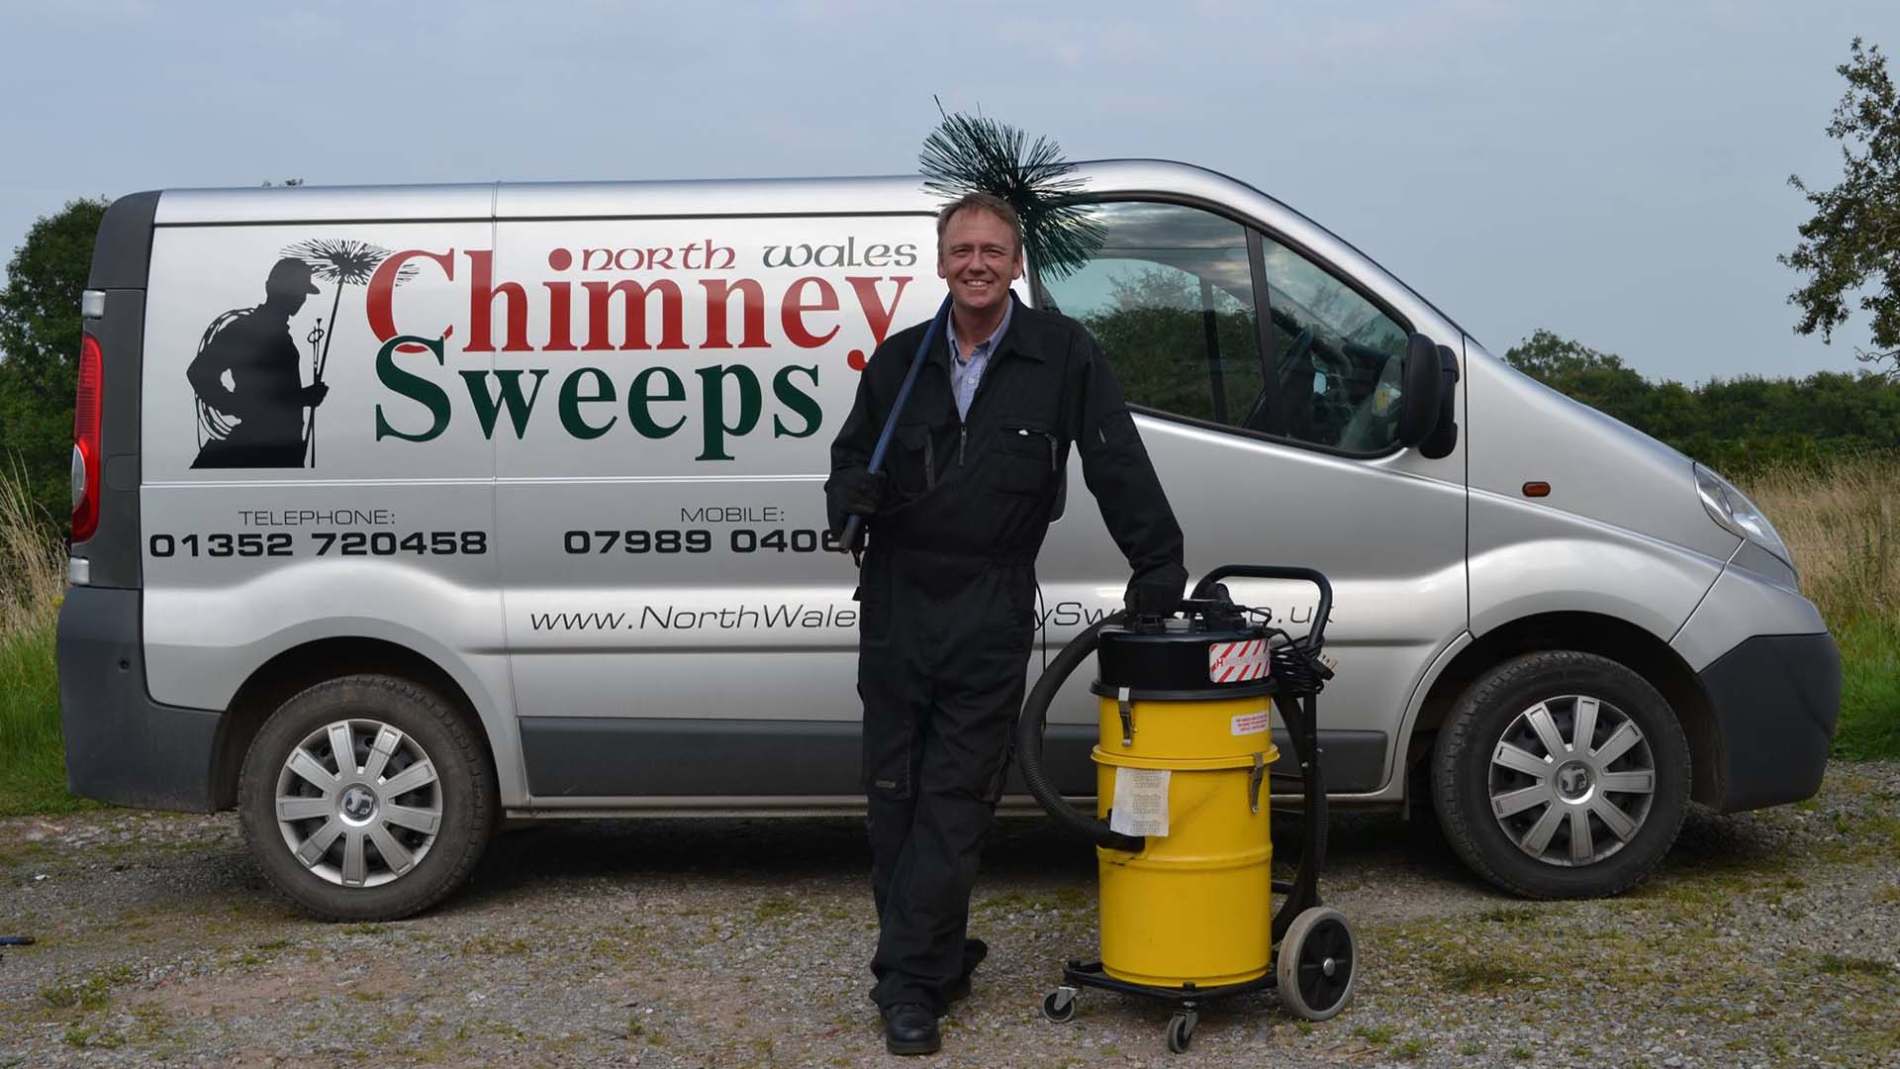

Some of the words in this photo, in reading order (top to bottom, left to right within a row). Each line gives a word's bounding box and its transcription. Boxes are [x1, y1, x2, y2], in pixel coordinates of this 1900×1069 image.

[366, 247, 914, 372] Chimney
[375, 335, 824, 462] Sweeps
[238, 509, 395, 526] TELEPHONE:
[681, 507, 784, 523] MOBILE:
[150, 533, 294, 557] 01352
[311, 530, 488, 556] 720458
[564, 530, 712, 554] 07989
